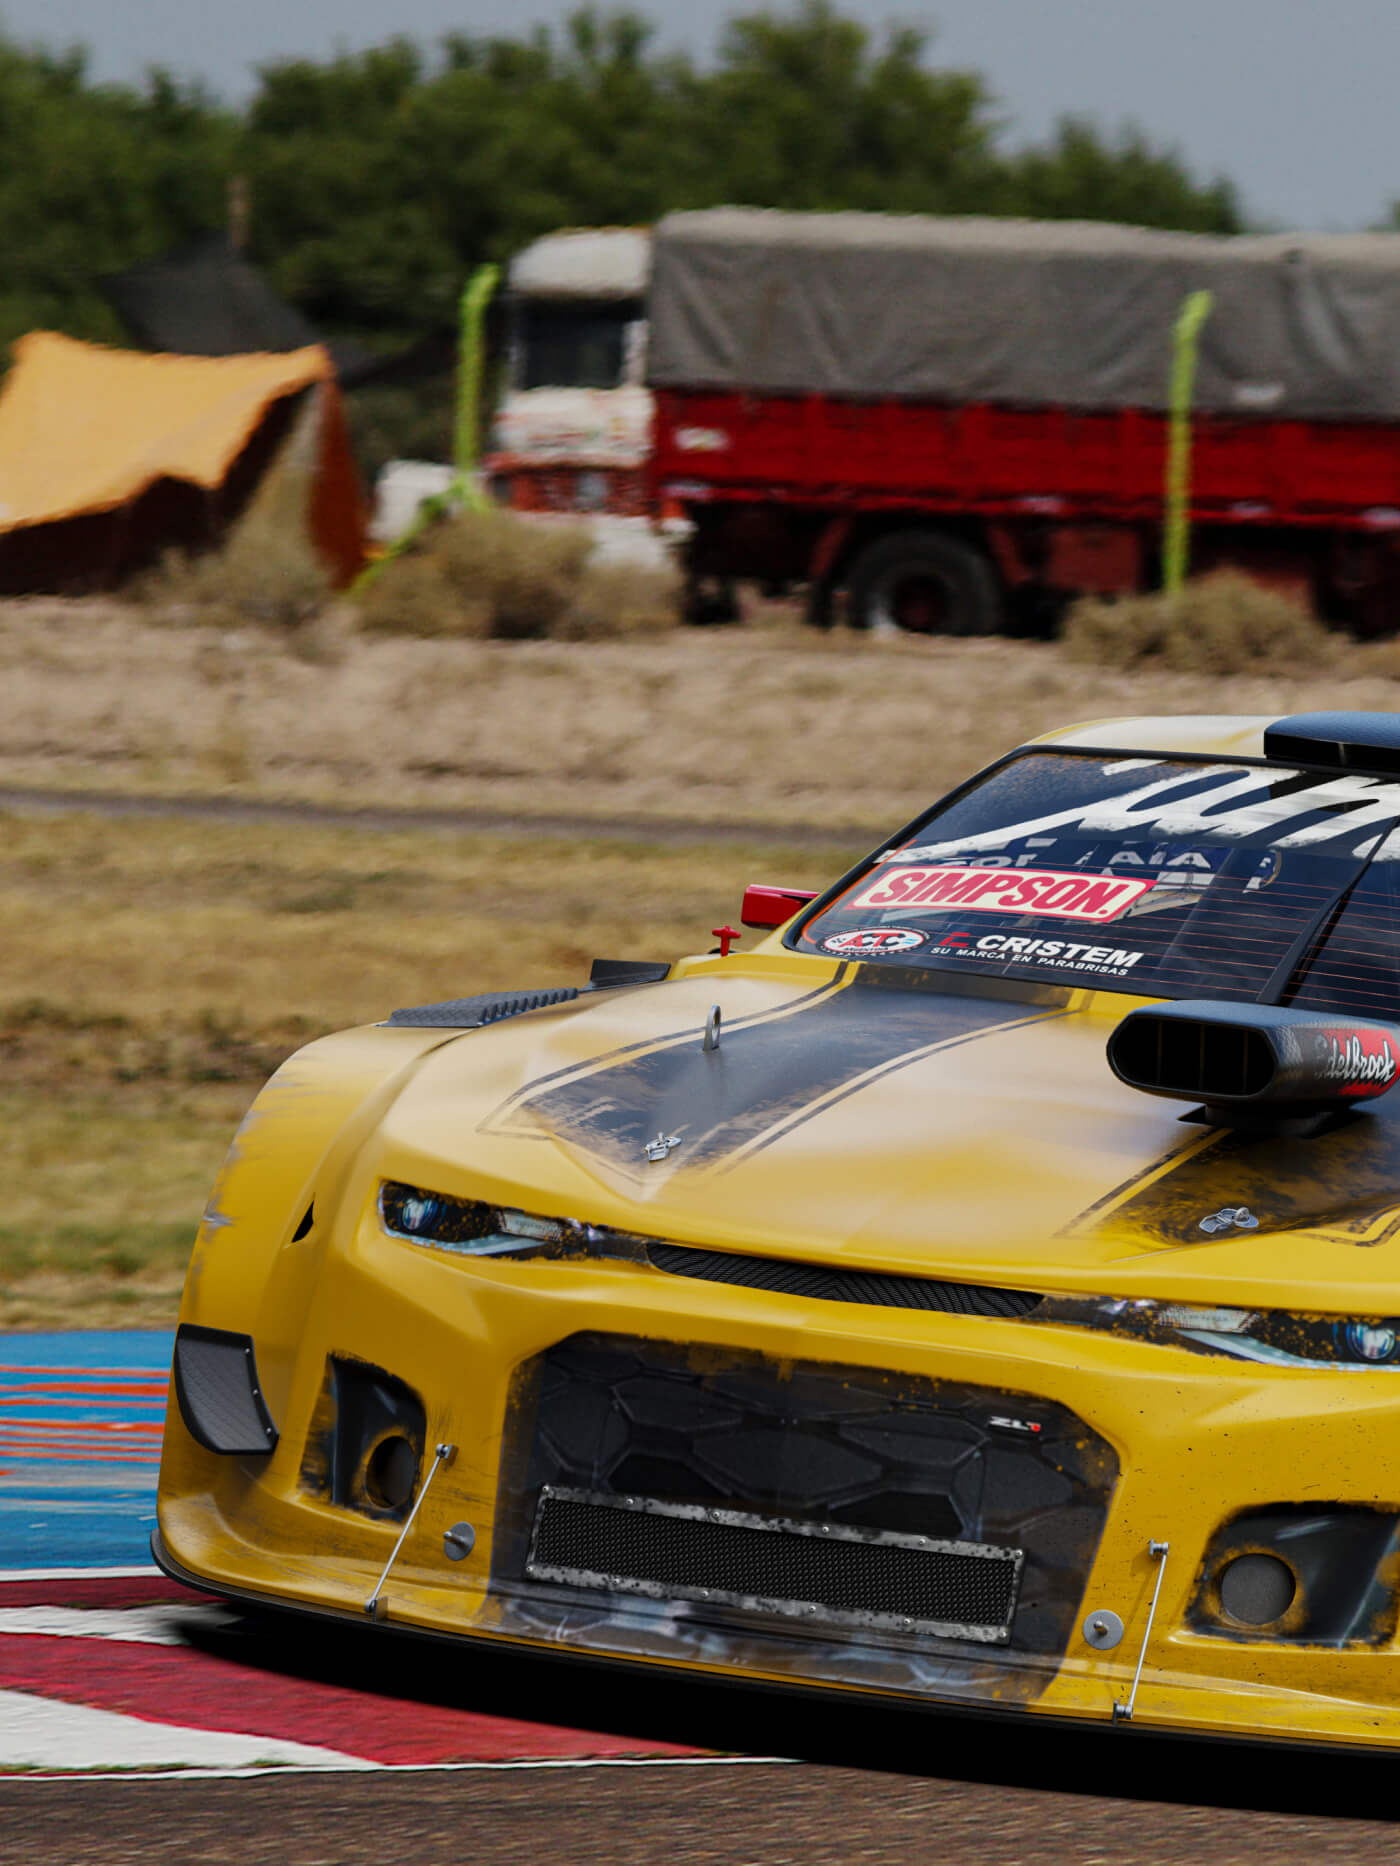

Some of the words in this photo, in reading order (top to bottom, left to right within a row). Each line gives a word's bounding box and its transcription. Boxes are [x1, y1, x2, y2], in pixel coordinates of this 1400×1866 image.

[931, 947, 950, 955] SU
[956, 949, 1005, 961] MARCA
[1012, 954, 1030, 963] EN
[1037, 957, 1129, 977] PARABRISAS
[976, 934, 1145, 968] CRISTEM
